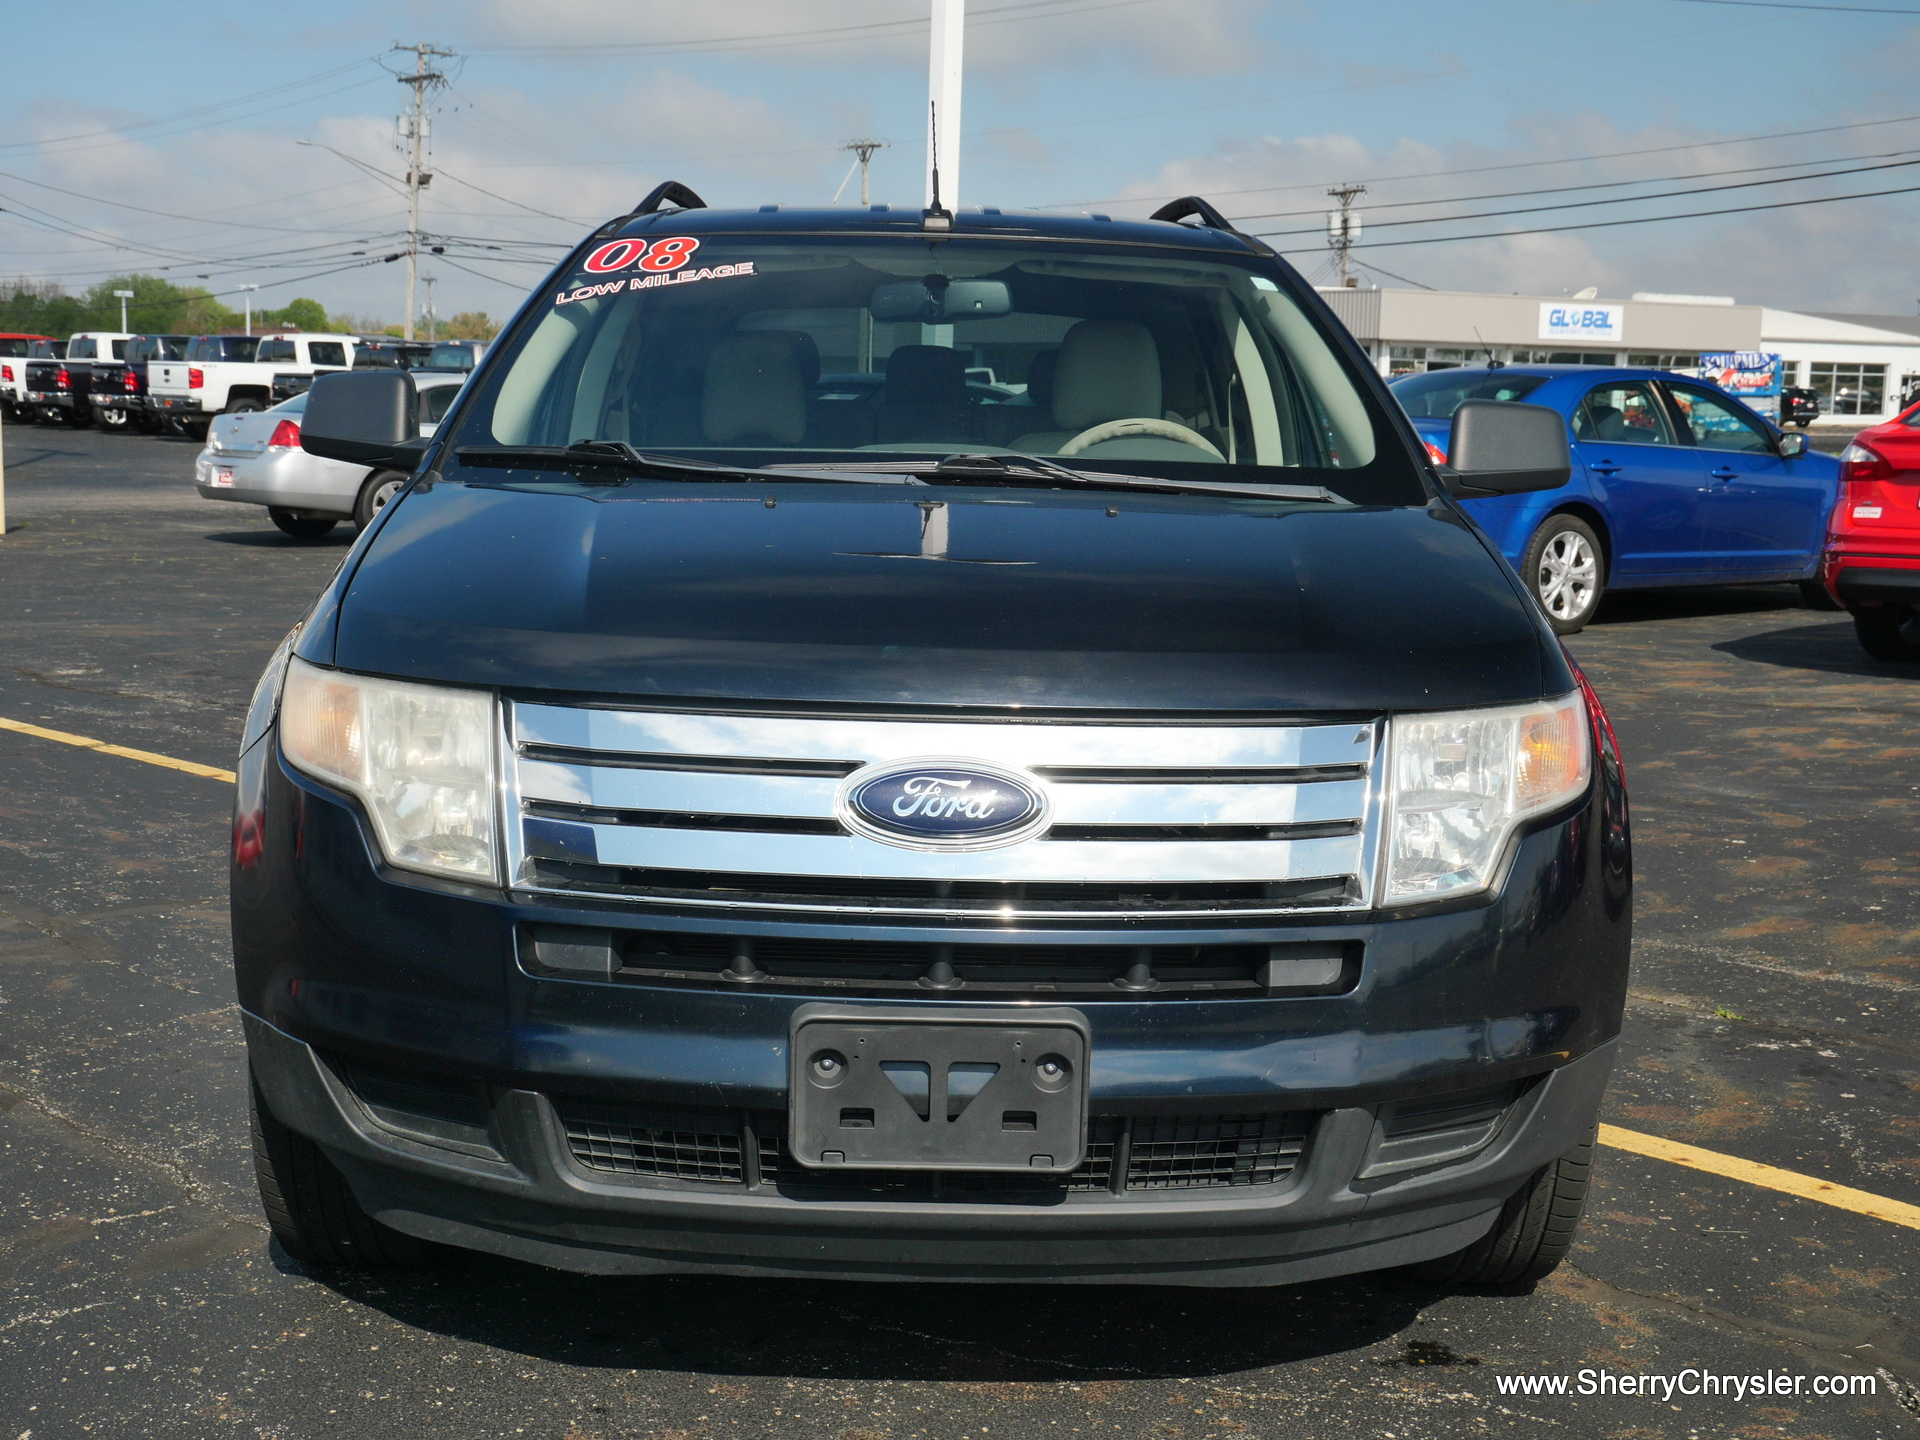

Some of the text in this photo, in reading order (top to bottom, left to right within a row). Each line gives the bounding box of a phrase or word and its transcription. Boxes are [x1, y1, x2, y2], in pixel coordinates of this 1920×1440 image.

[584, 237, 700, 273] 08
[556, 261, 754, 305] LOW MILEAGE
[892, 777, 998, 819] Ford
